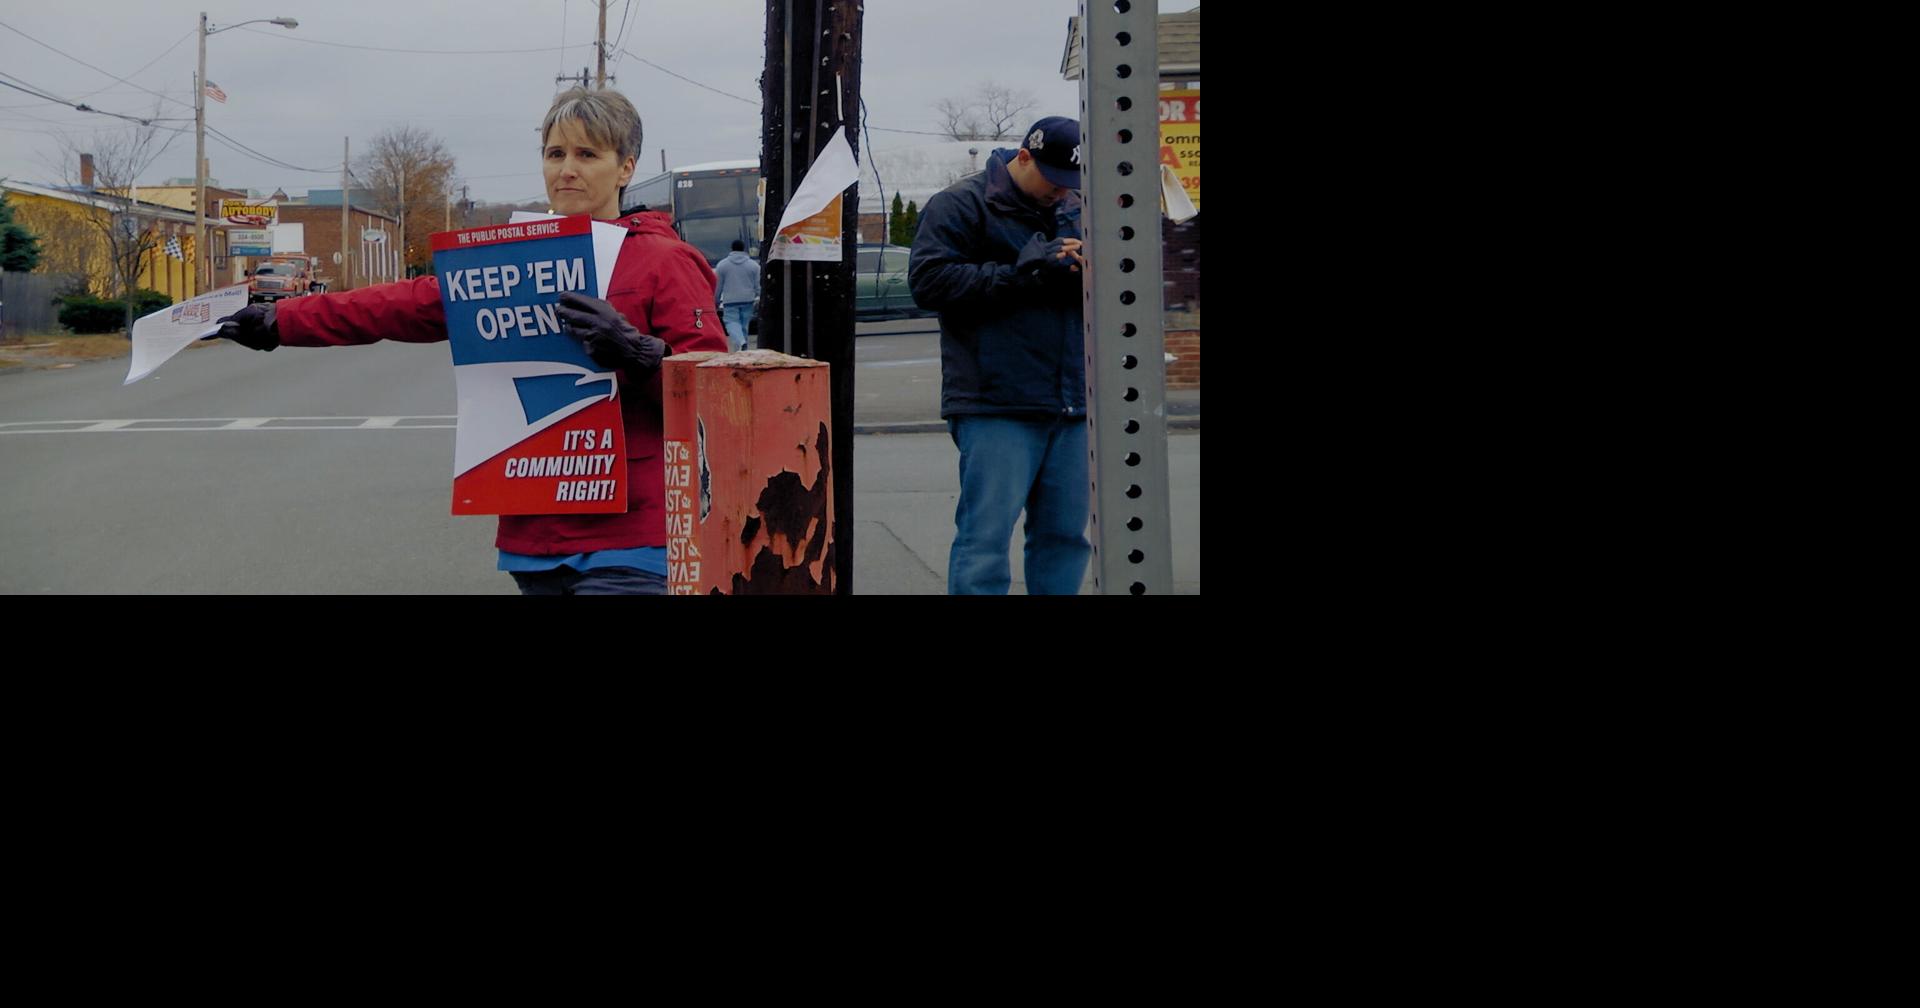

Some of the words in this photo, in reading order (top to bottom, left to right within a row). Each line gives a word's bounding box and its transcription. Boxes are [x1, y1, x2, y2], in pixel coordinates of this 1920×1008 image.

[221, 206, 276, 218] AUTOBODY
[457, 233, 471, 244] THE
[471, 229, 497, 243] PUBLIC
[498, 226, 525, 240] POSTAL
[526, 221, 560, 236] SERVICE
[446, 264, 520, 302] KEEP
[526, 257, 586, 294] 'EM
[562, 429, 596, 451] IT'S
[600, 428, 613, 450] A
[504, 453, 616, 479] COMMUNITY
[556, 479, 616, 502] RIGHT!
